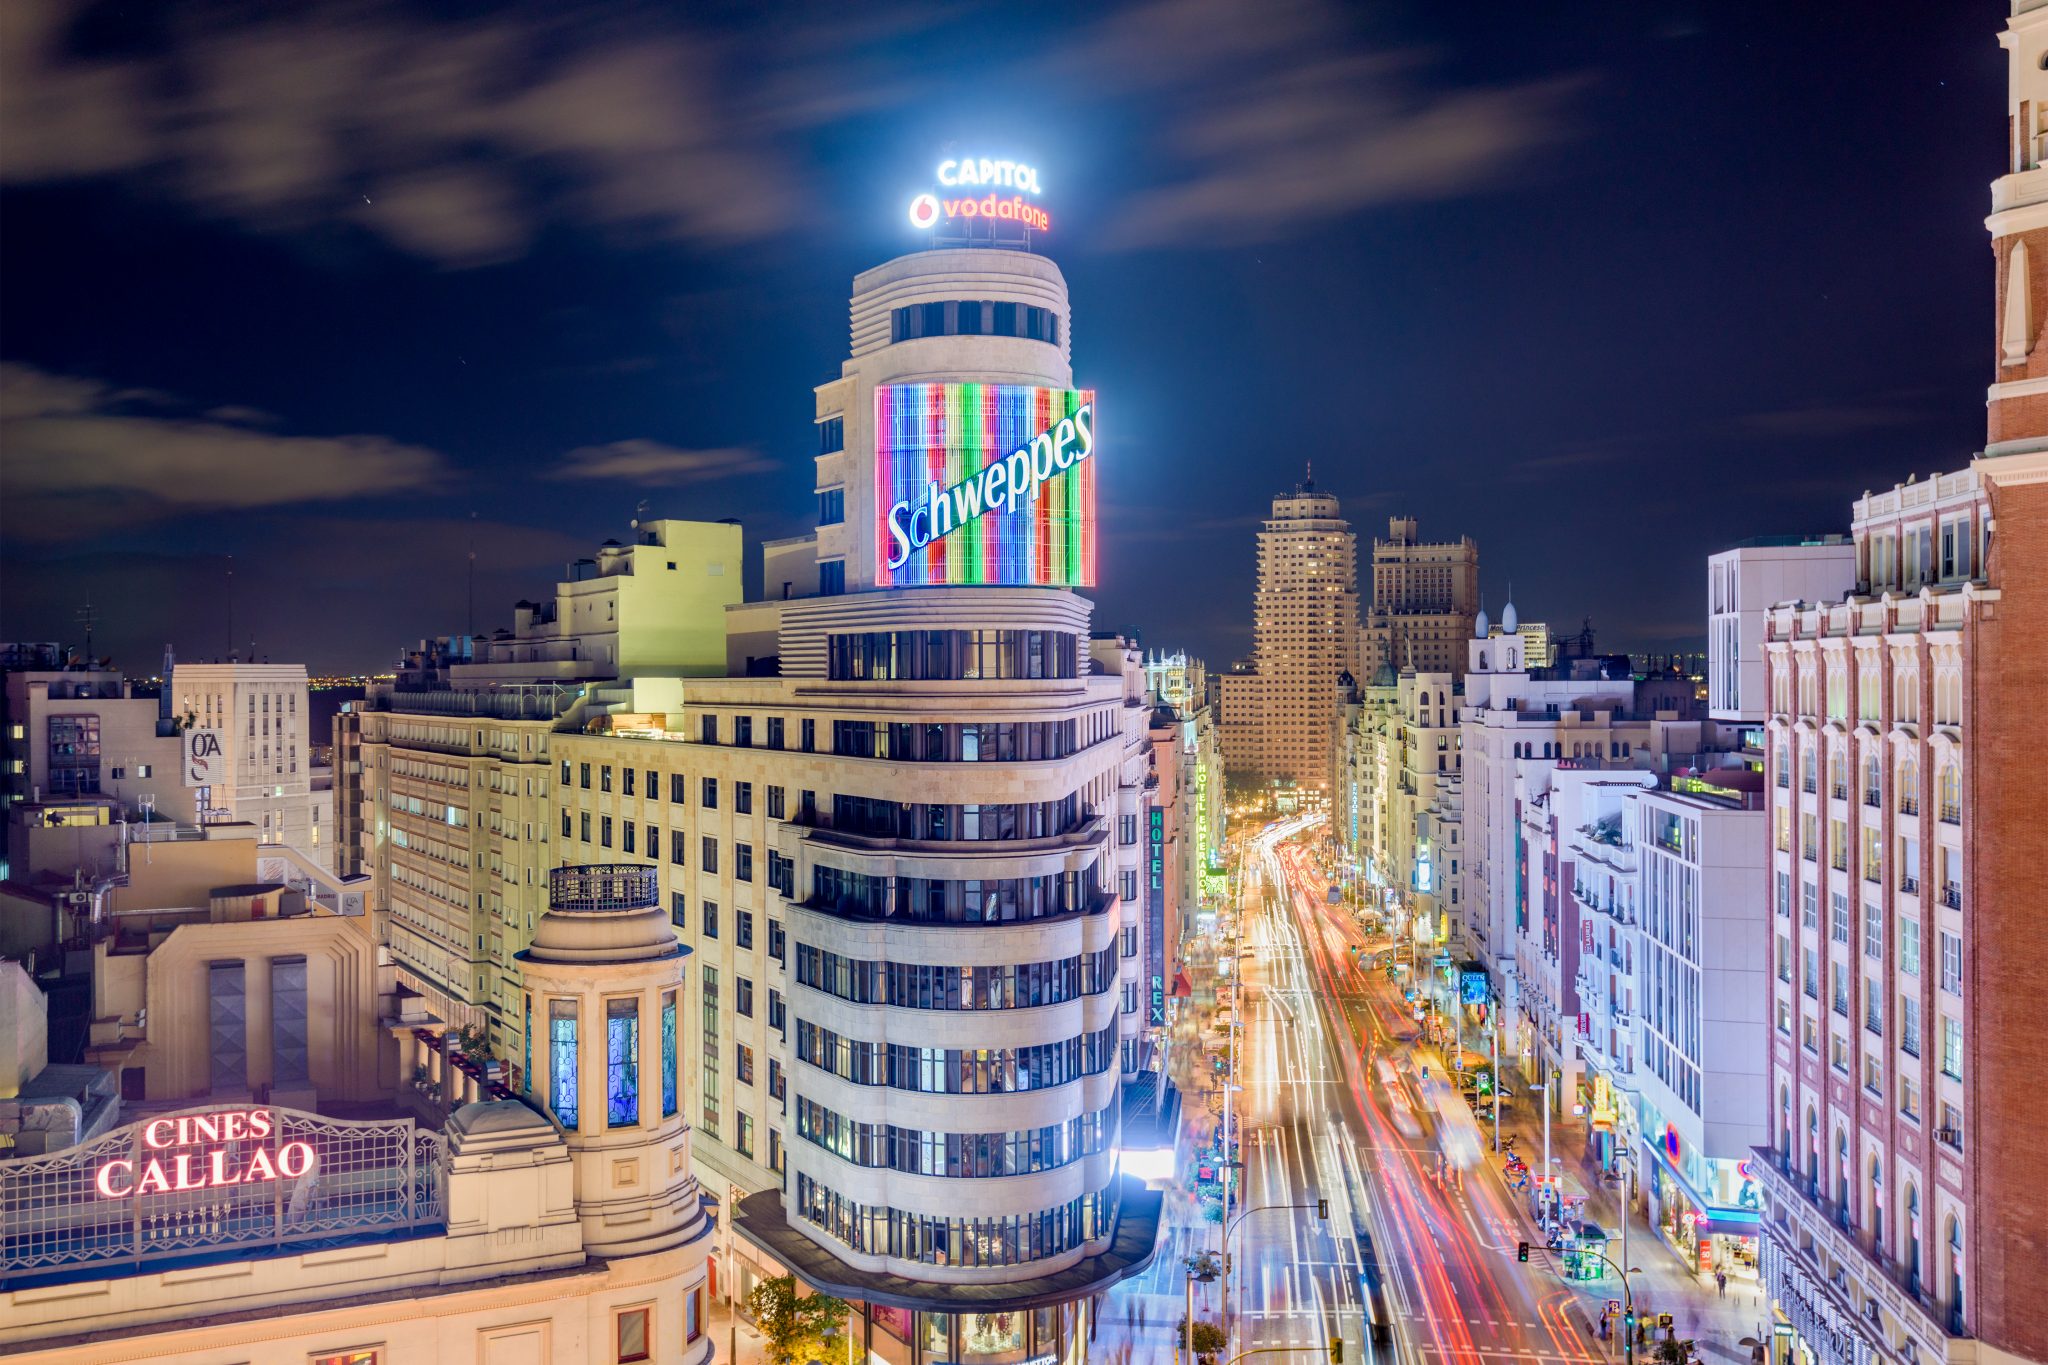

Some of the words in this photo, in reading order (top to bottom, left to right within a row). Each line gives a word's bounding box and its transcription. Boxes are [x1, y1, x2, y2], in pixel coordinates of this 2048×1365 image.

[937, 159, 1041, 194] CAPITOL
[943, 194, 1048, 231] vodafone
[888, 403, 1093, 569] Schweppes
[1152, 812, 1162, 889] HOTEL
[1199, 815, 1207, 898] EMPERADOR
[1152, 976, 1164, 1021] REX
[145, 1110, 271, 1149] CINES
[97, 1142, 315, 1198] CALLAO
